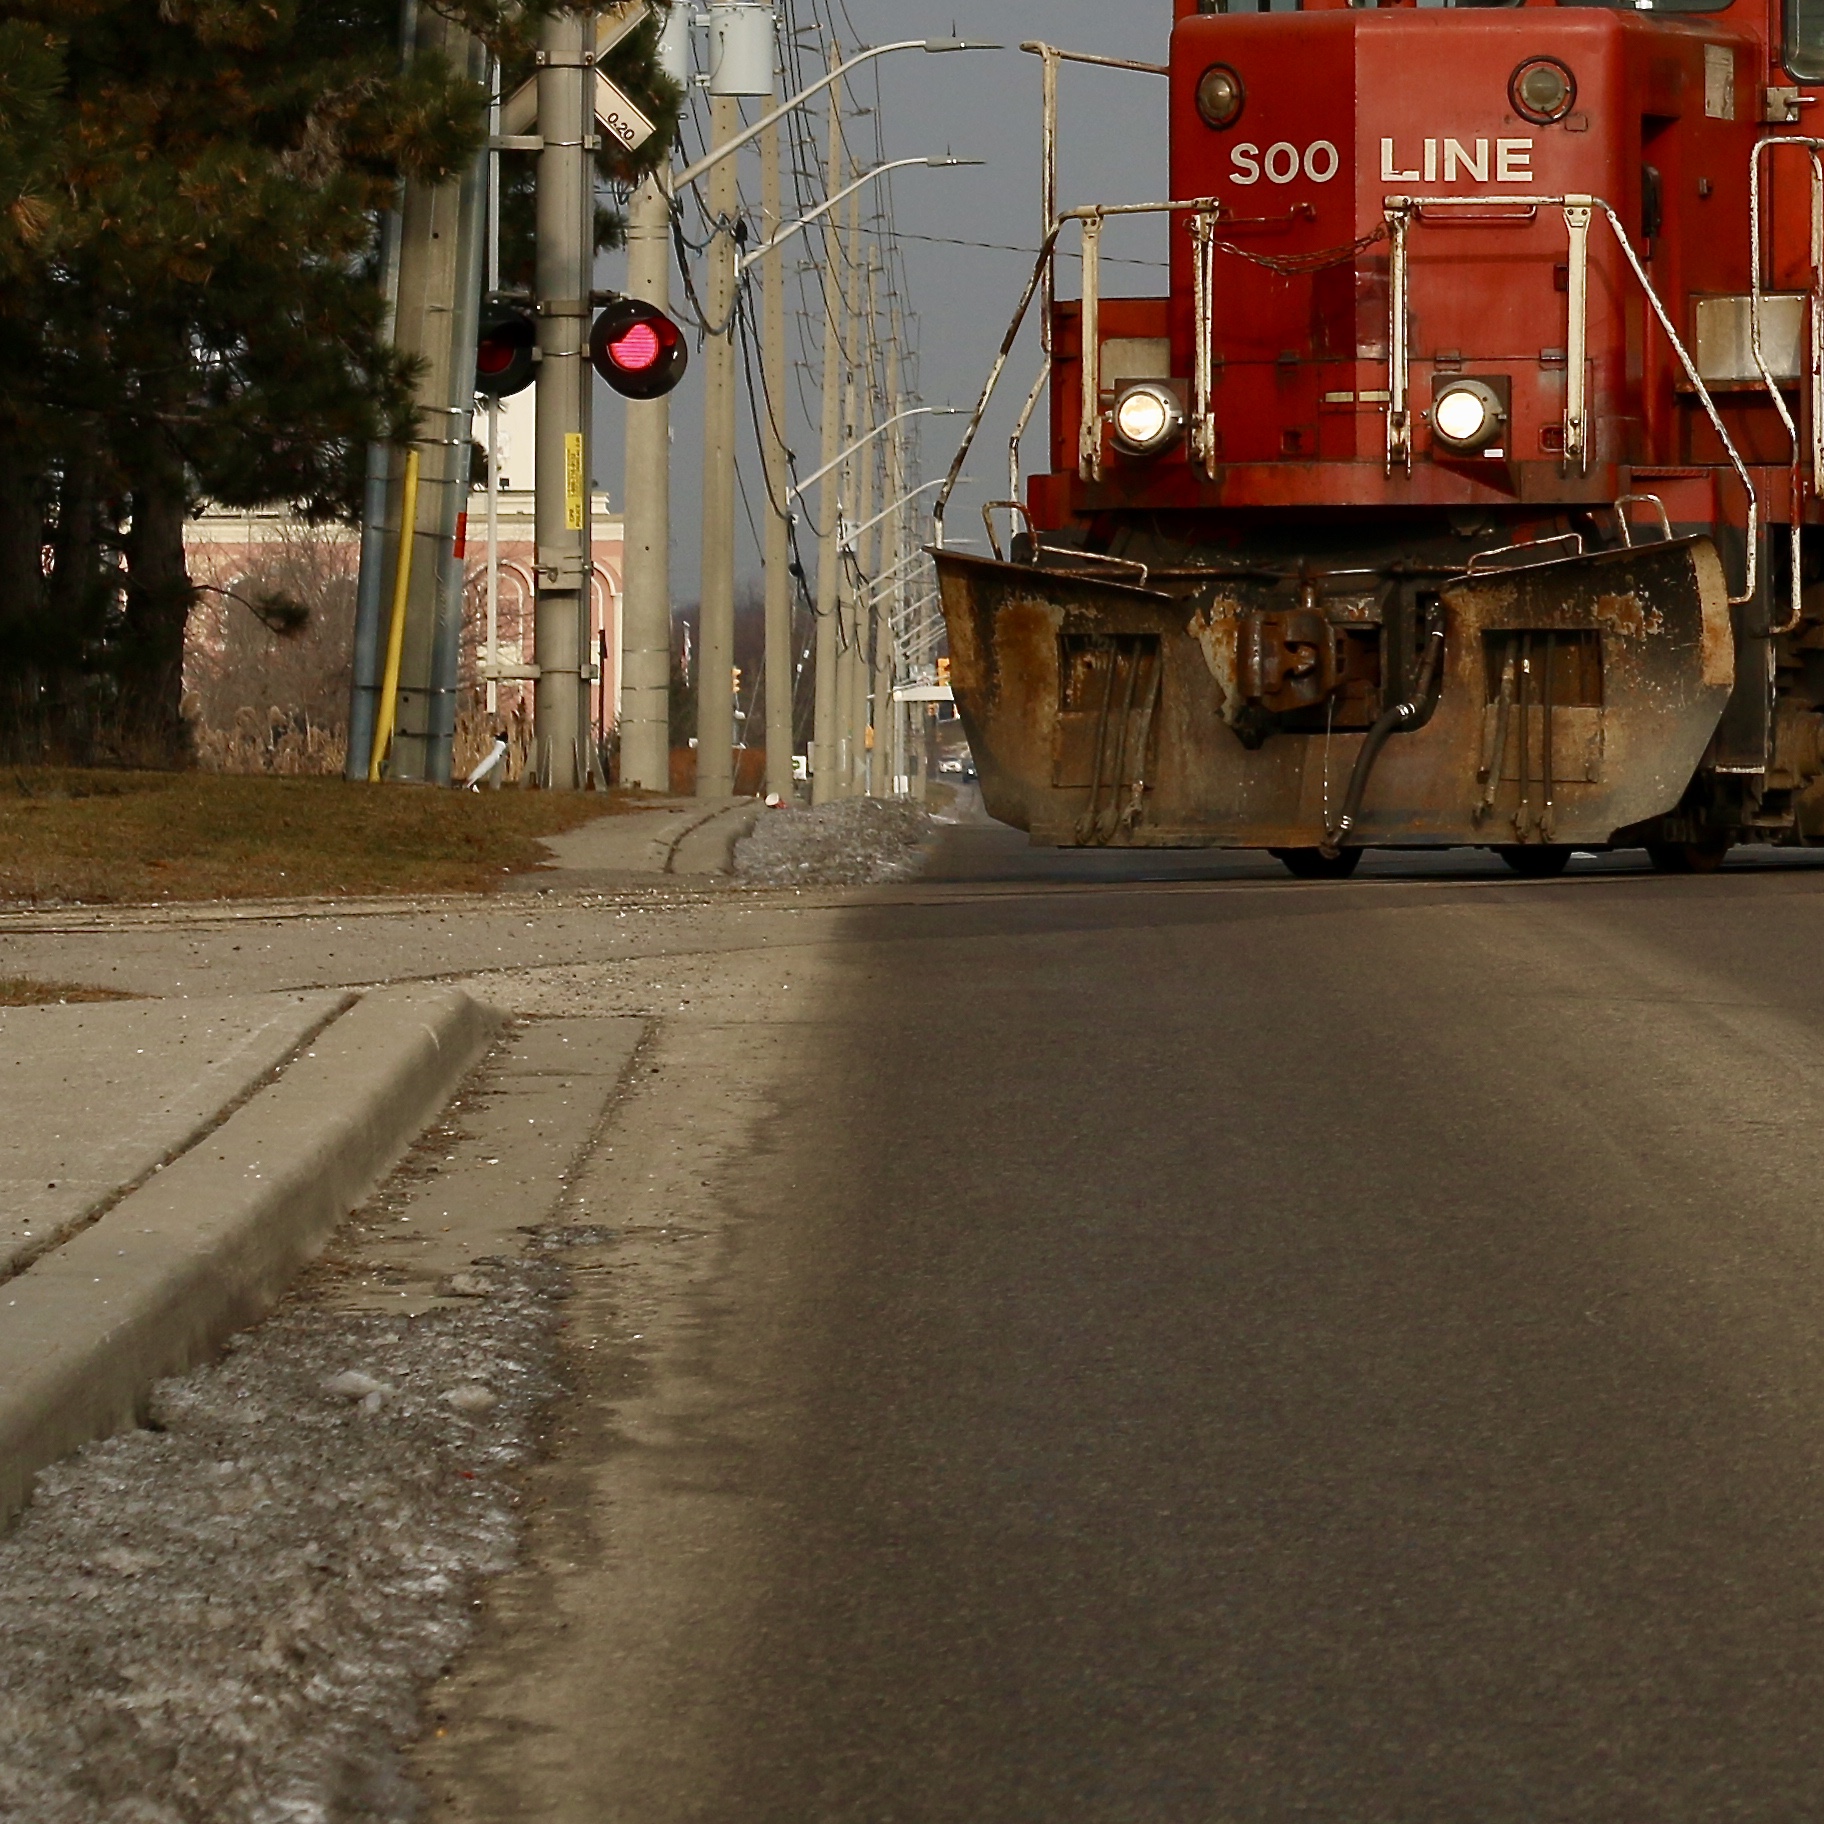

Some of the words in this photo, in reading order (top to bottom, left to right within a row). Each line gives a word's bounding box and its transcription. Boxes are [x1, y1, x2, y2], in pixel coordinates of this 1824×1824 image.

[607, 112, 635, 141] 0.20
[1229, 139, 1339, 185] SOO
[1380, 138, 1533, 182] LINE
